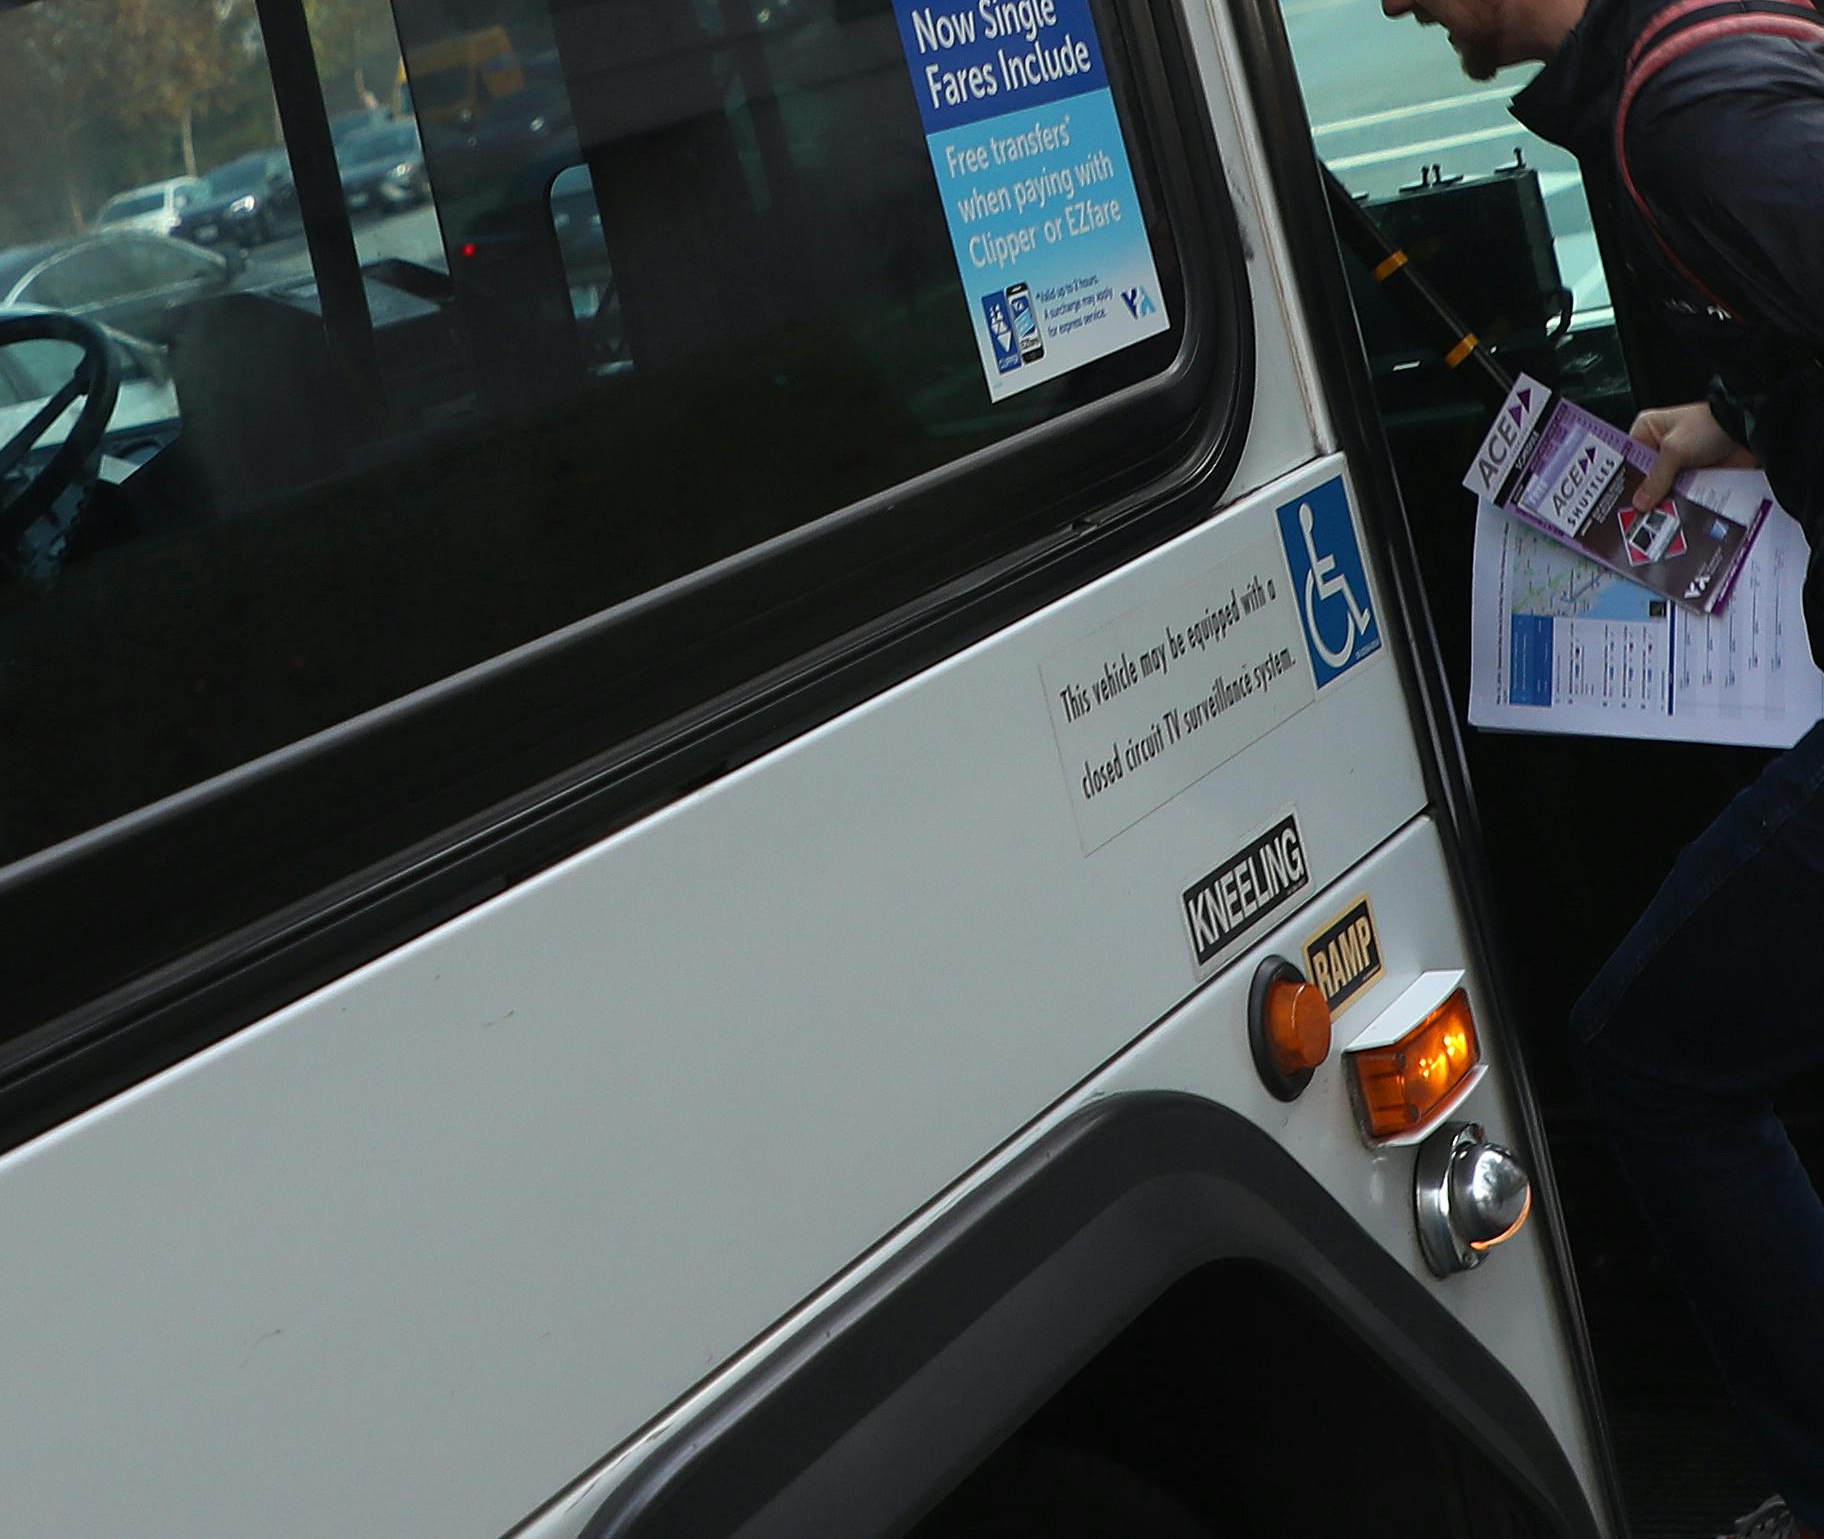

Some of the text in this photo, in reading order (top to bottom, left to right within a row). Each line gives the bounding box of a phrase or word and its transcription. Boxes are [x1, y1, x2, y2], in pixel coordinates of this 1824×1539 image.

[912, 7, 976, 54] Now
[925, 33, 1091, 109] Fares Include
[945, 145, 990, 178] Free
[957, 149, 1114, 223] when paying with
[968, 198, 1122, 269] Clipper or EZfare
[1478, 416, 1518, 490] ACE
[1552, 467, 1584, 516] ACE
[1567, 460, 1616, 527] SHUTTLES
[1060, 574, 1277, 723] This vehicle may be equipped with a
[1081, 647, 1296, 799] closed circuit TV surveillance system.
[1188, 827, 1305, 953] KNEELING
[1312, 915, 1372, 998] RAMP
